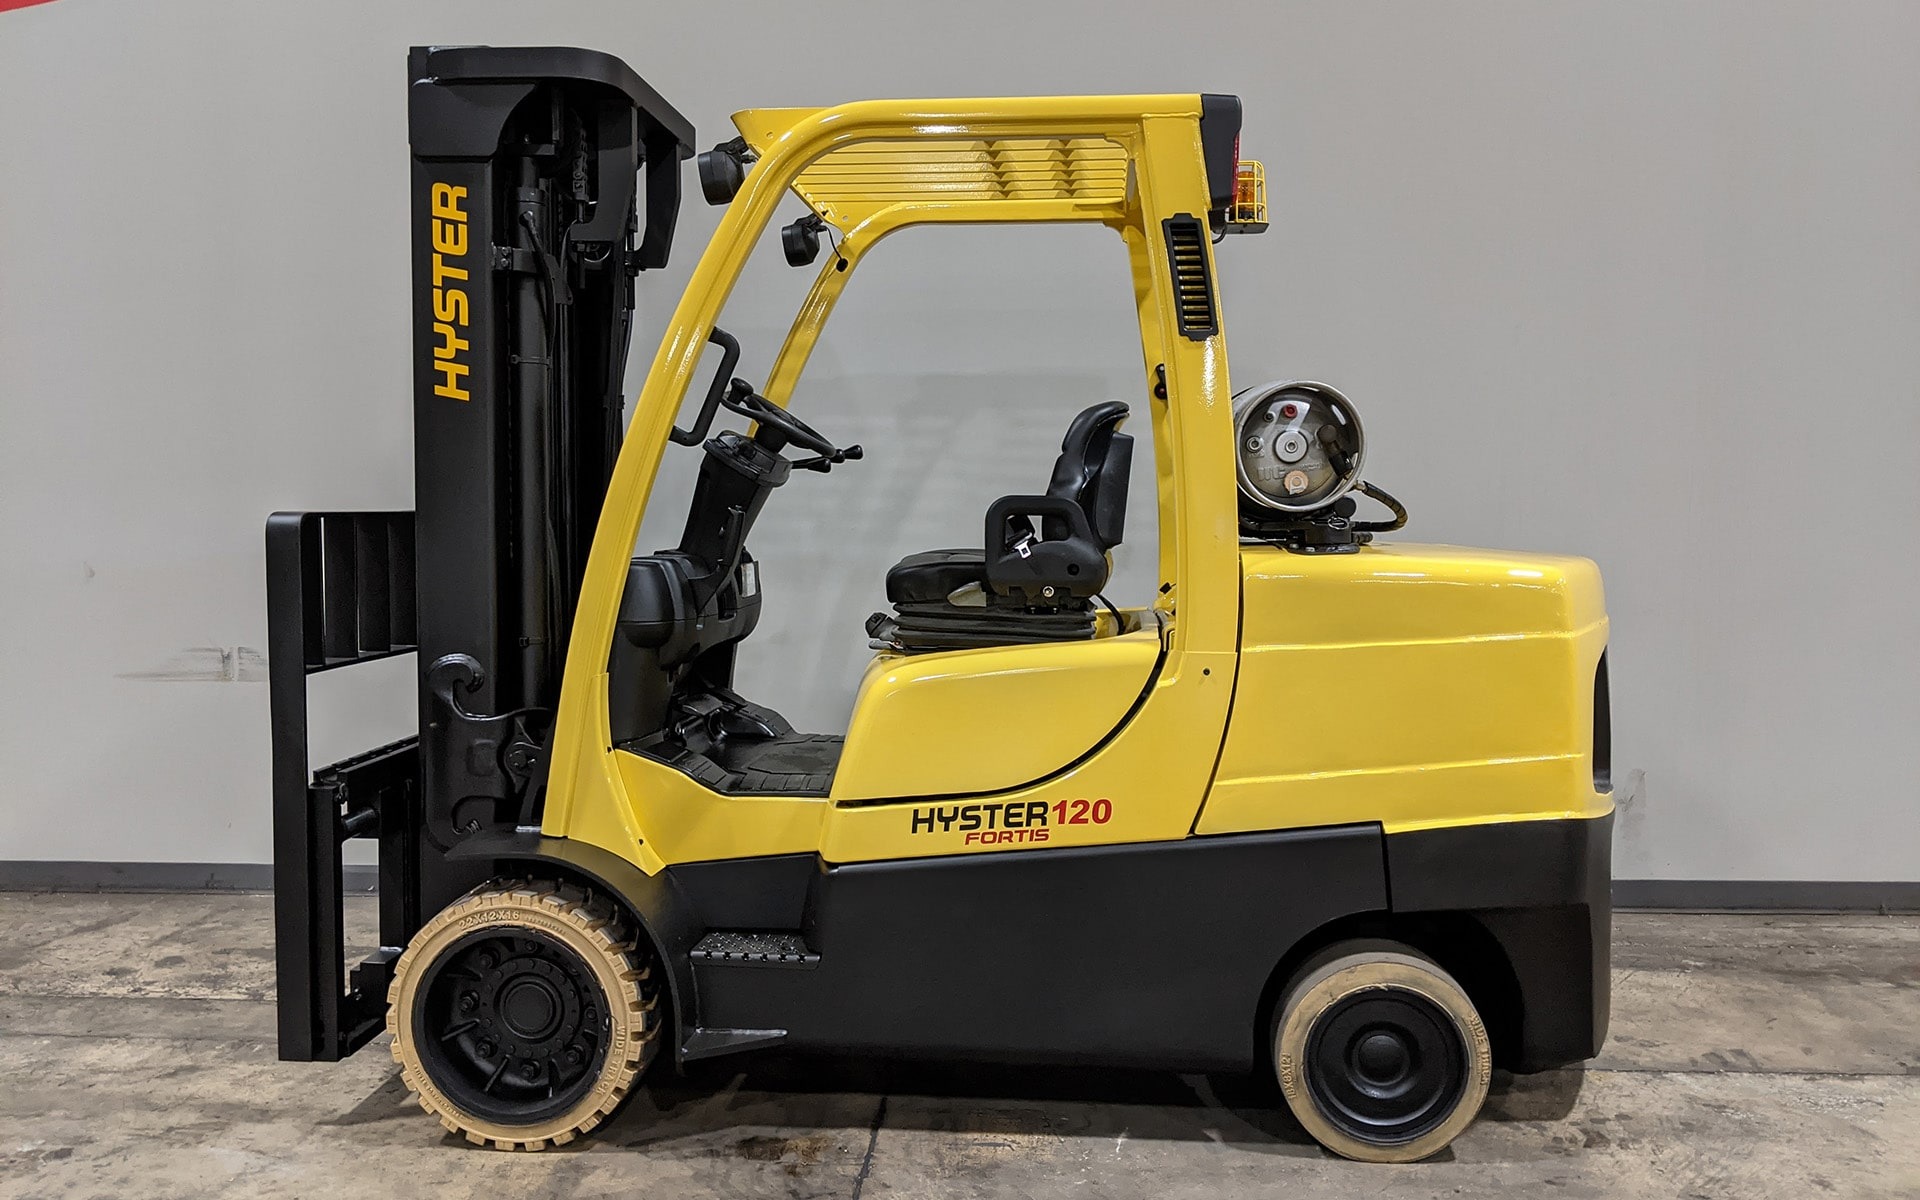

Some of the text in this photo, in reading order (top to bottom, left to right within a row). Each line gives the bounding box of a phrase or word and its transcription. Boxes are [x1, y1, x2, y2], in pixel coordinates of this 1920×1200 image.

[432, 182, 470, 402] HYSTER
[911, 799, 1113, 834] HYSTER 120
[964, 828, 1050, 846] FORTIS
[458, 909, 521, 931] 22X12X16
[596, 1024, 627, 1096] WIDE TRACK
